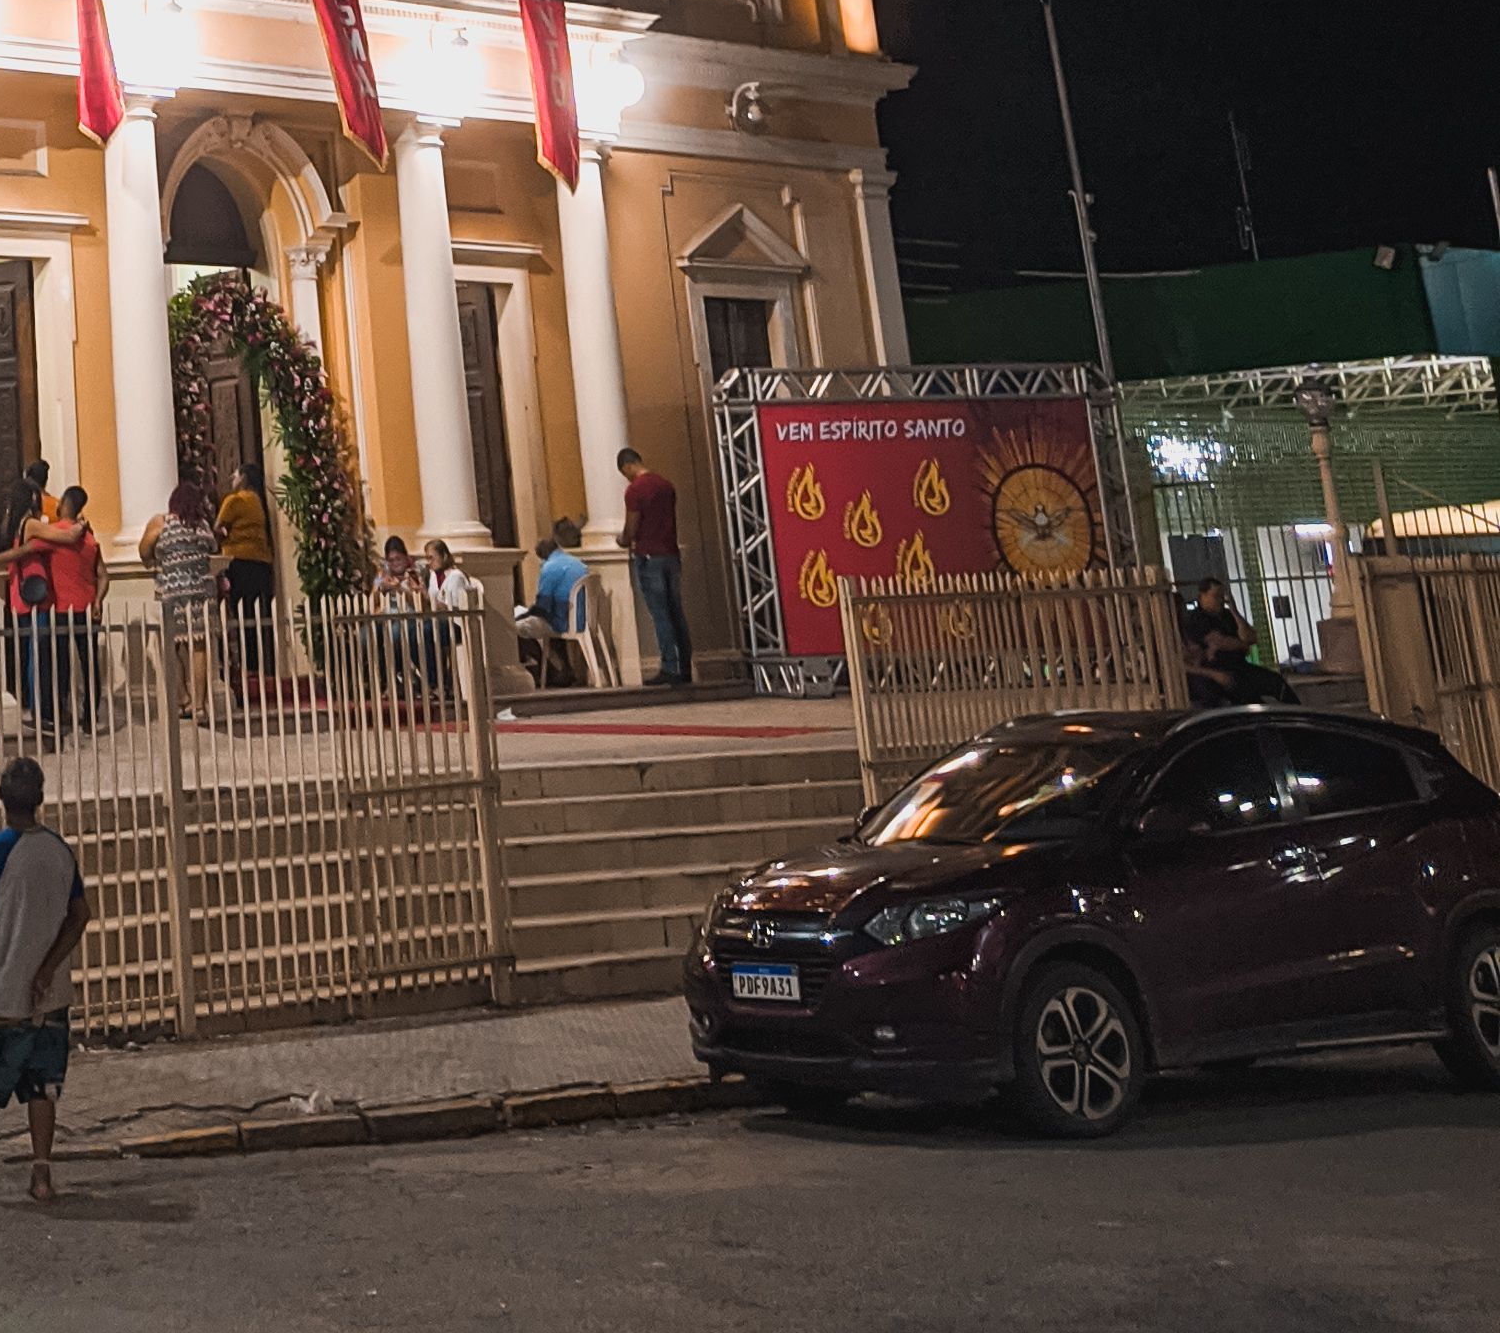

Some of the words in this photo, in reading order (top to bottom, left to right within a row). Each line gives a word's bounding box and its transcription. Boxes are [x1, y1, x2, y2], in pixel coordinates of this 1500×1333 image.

[776, 421, 813, 442] VEM
[819, 416, 897, 441] ESPÍRITO
[904, 418, 965, 439] SANTO
[738, 974, 793, 997] PDF9A31
